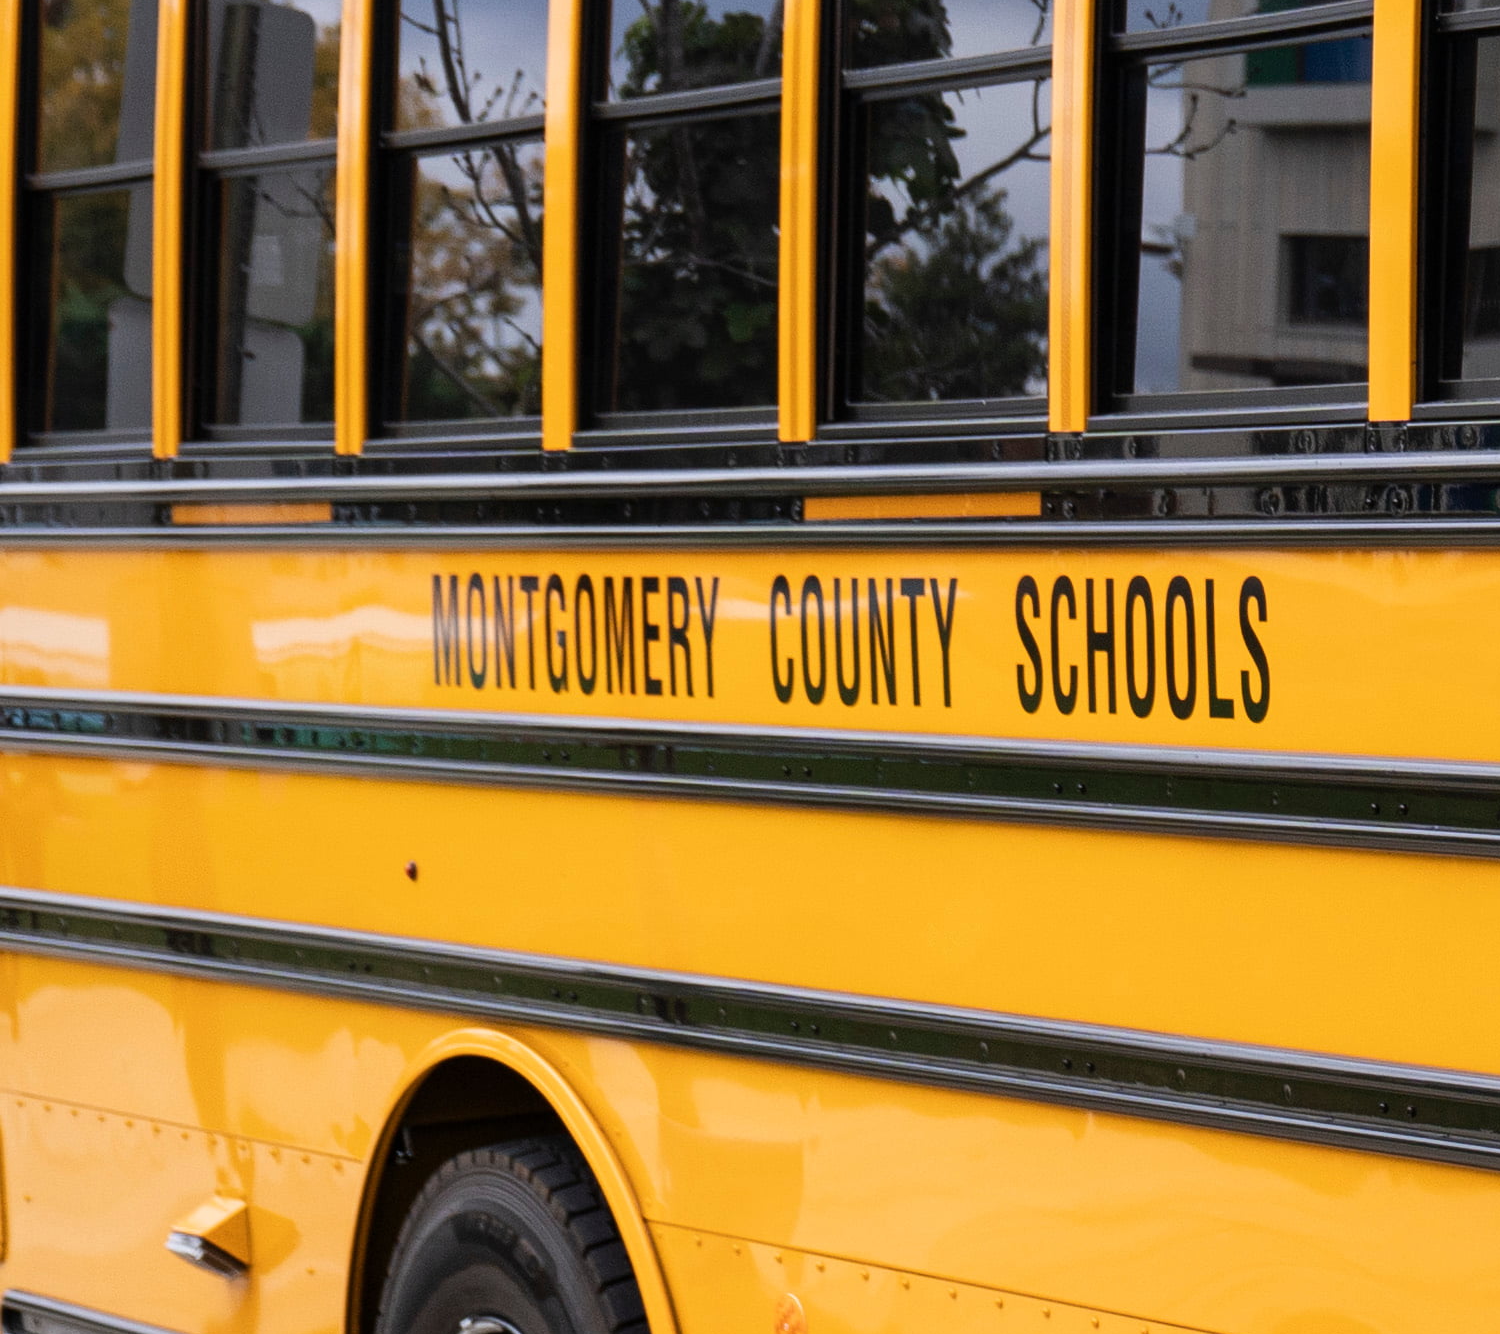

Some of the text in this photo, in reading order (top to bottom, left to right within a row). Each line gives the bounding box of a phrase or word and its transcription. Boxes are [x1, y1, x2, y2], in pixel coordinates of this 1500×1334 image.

[431, 573, 1271, 725] MONTGOMERY COUNTY SCHOOLS
